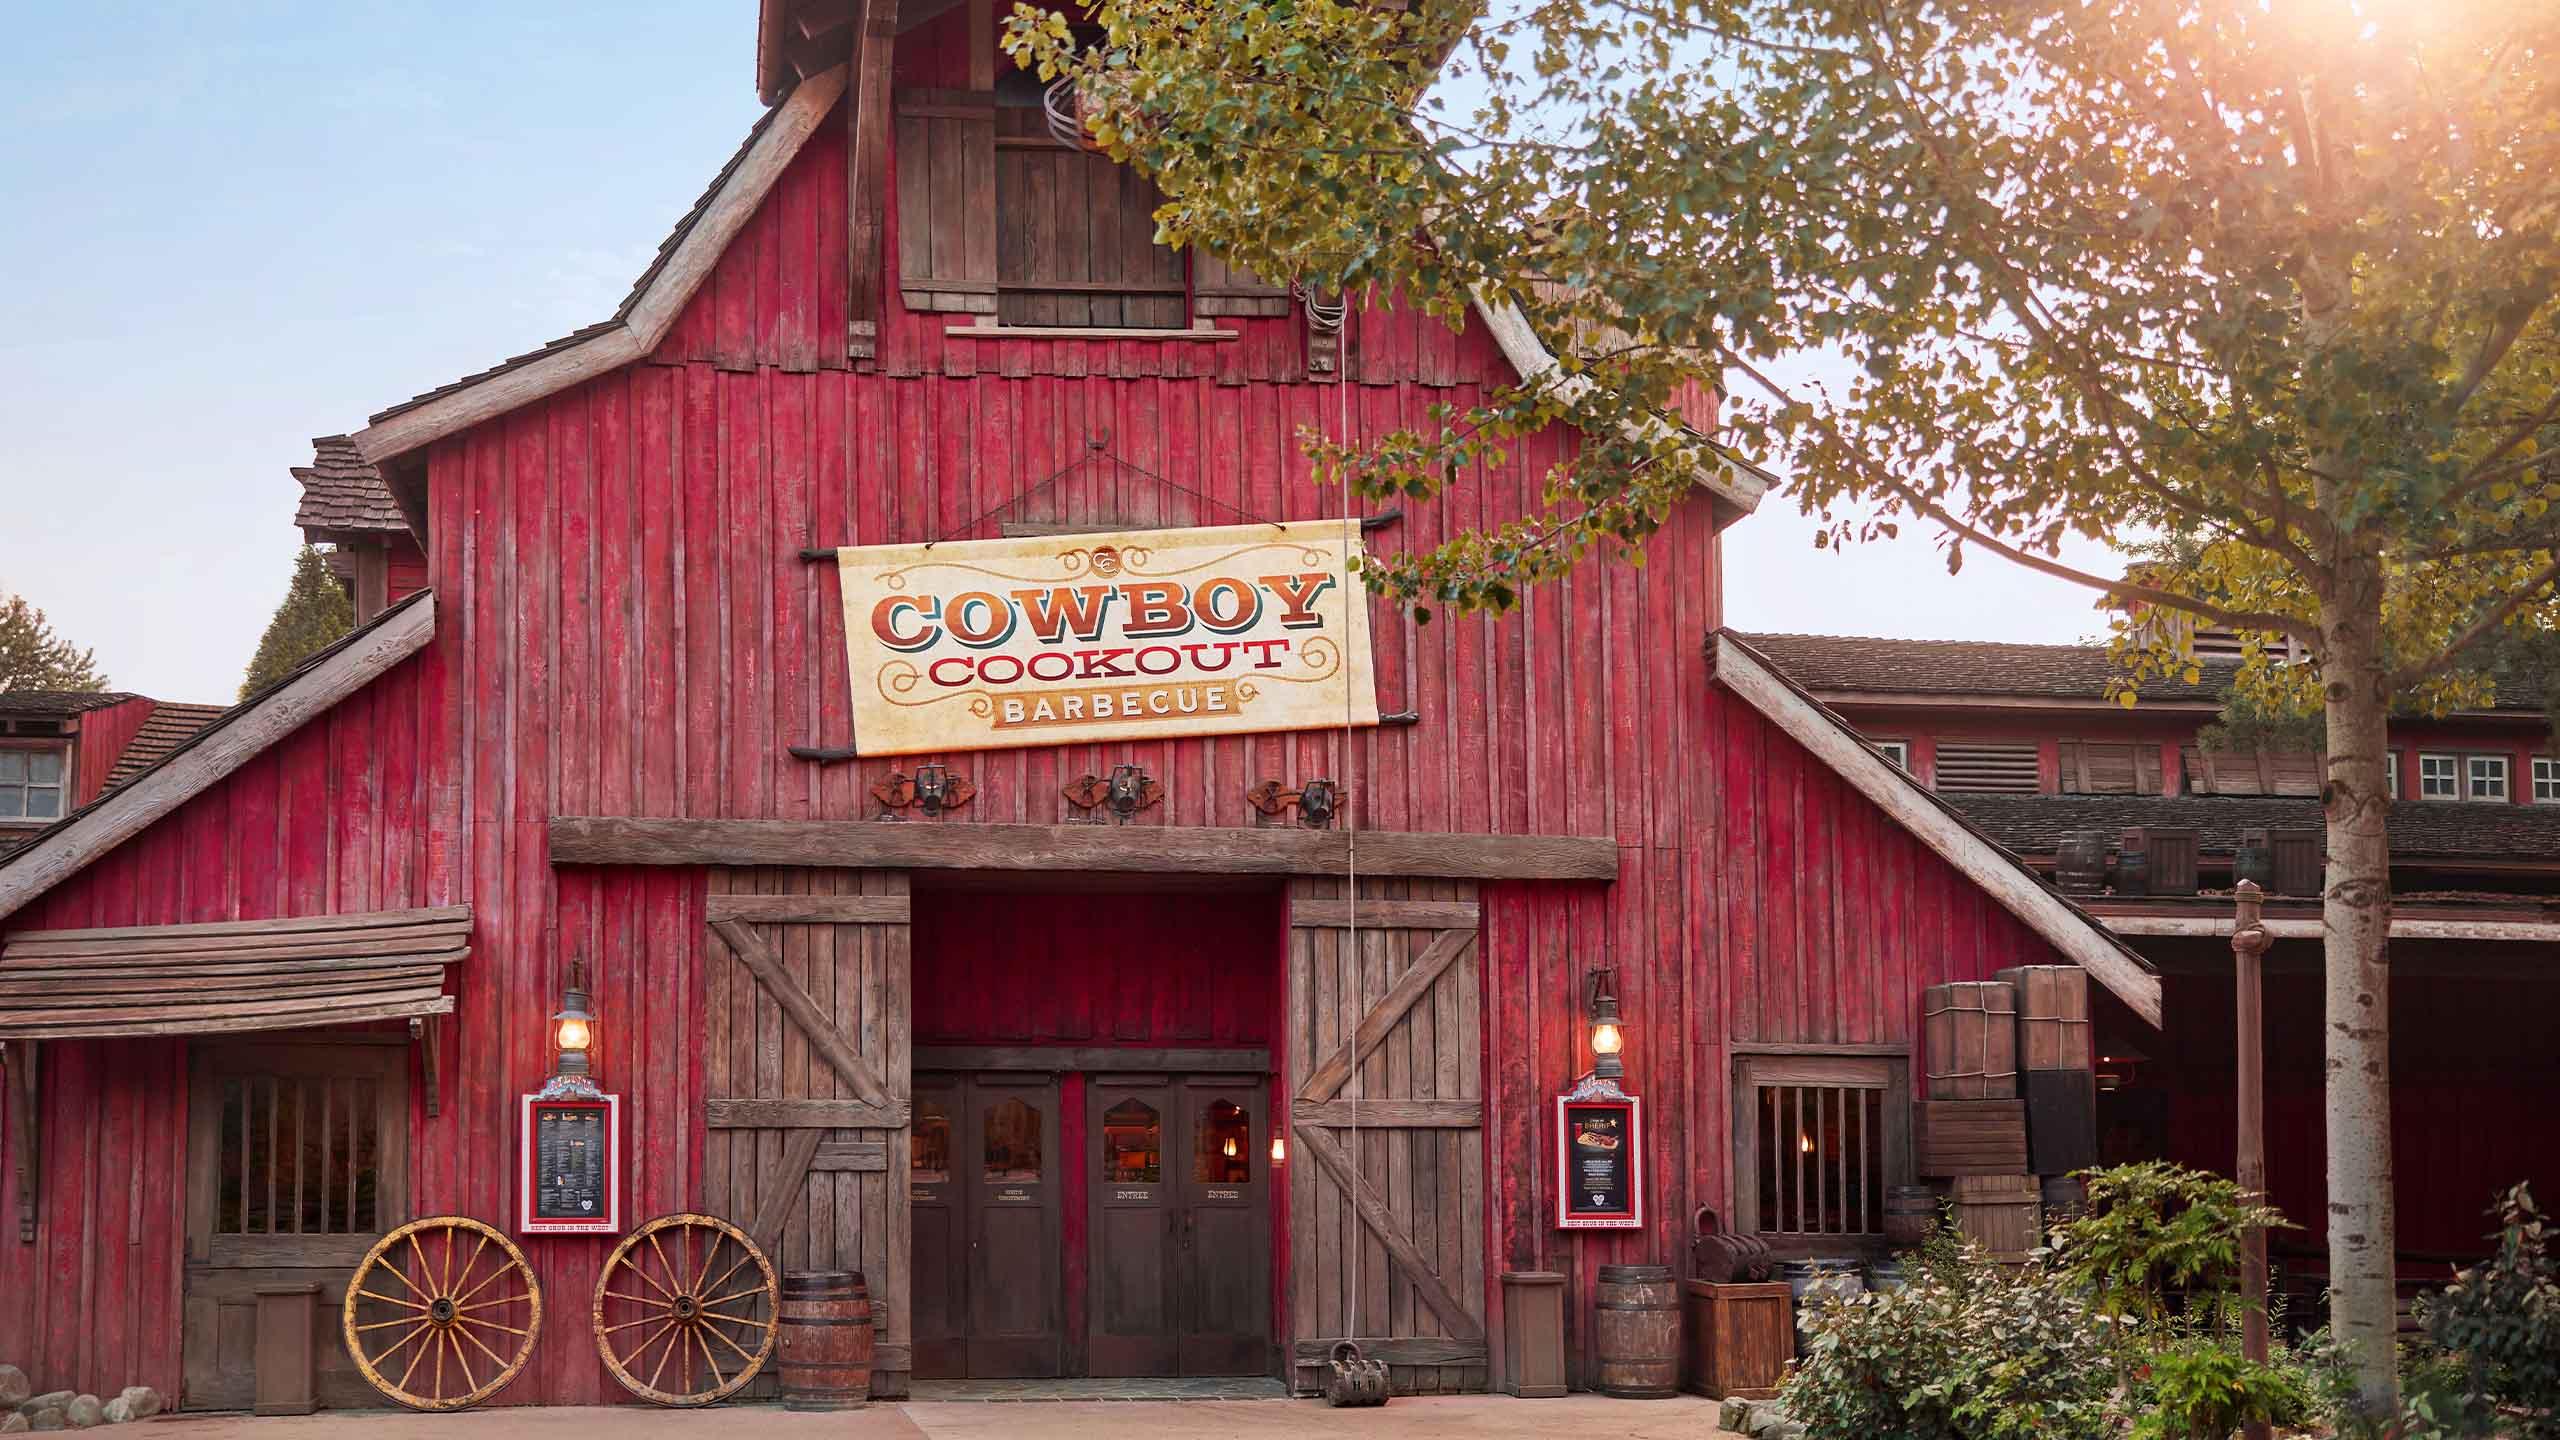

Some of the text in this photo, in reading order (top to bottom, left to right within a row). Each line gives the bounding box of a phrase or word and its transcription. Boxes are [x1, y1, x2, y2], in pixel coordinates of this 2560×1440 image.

[871, 572, 1336, 653] COWBOY
[928, 639, 1290, 687] COOKOUT
[1004, 686, 1228, 723] BARBECUE
